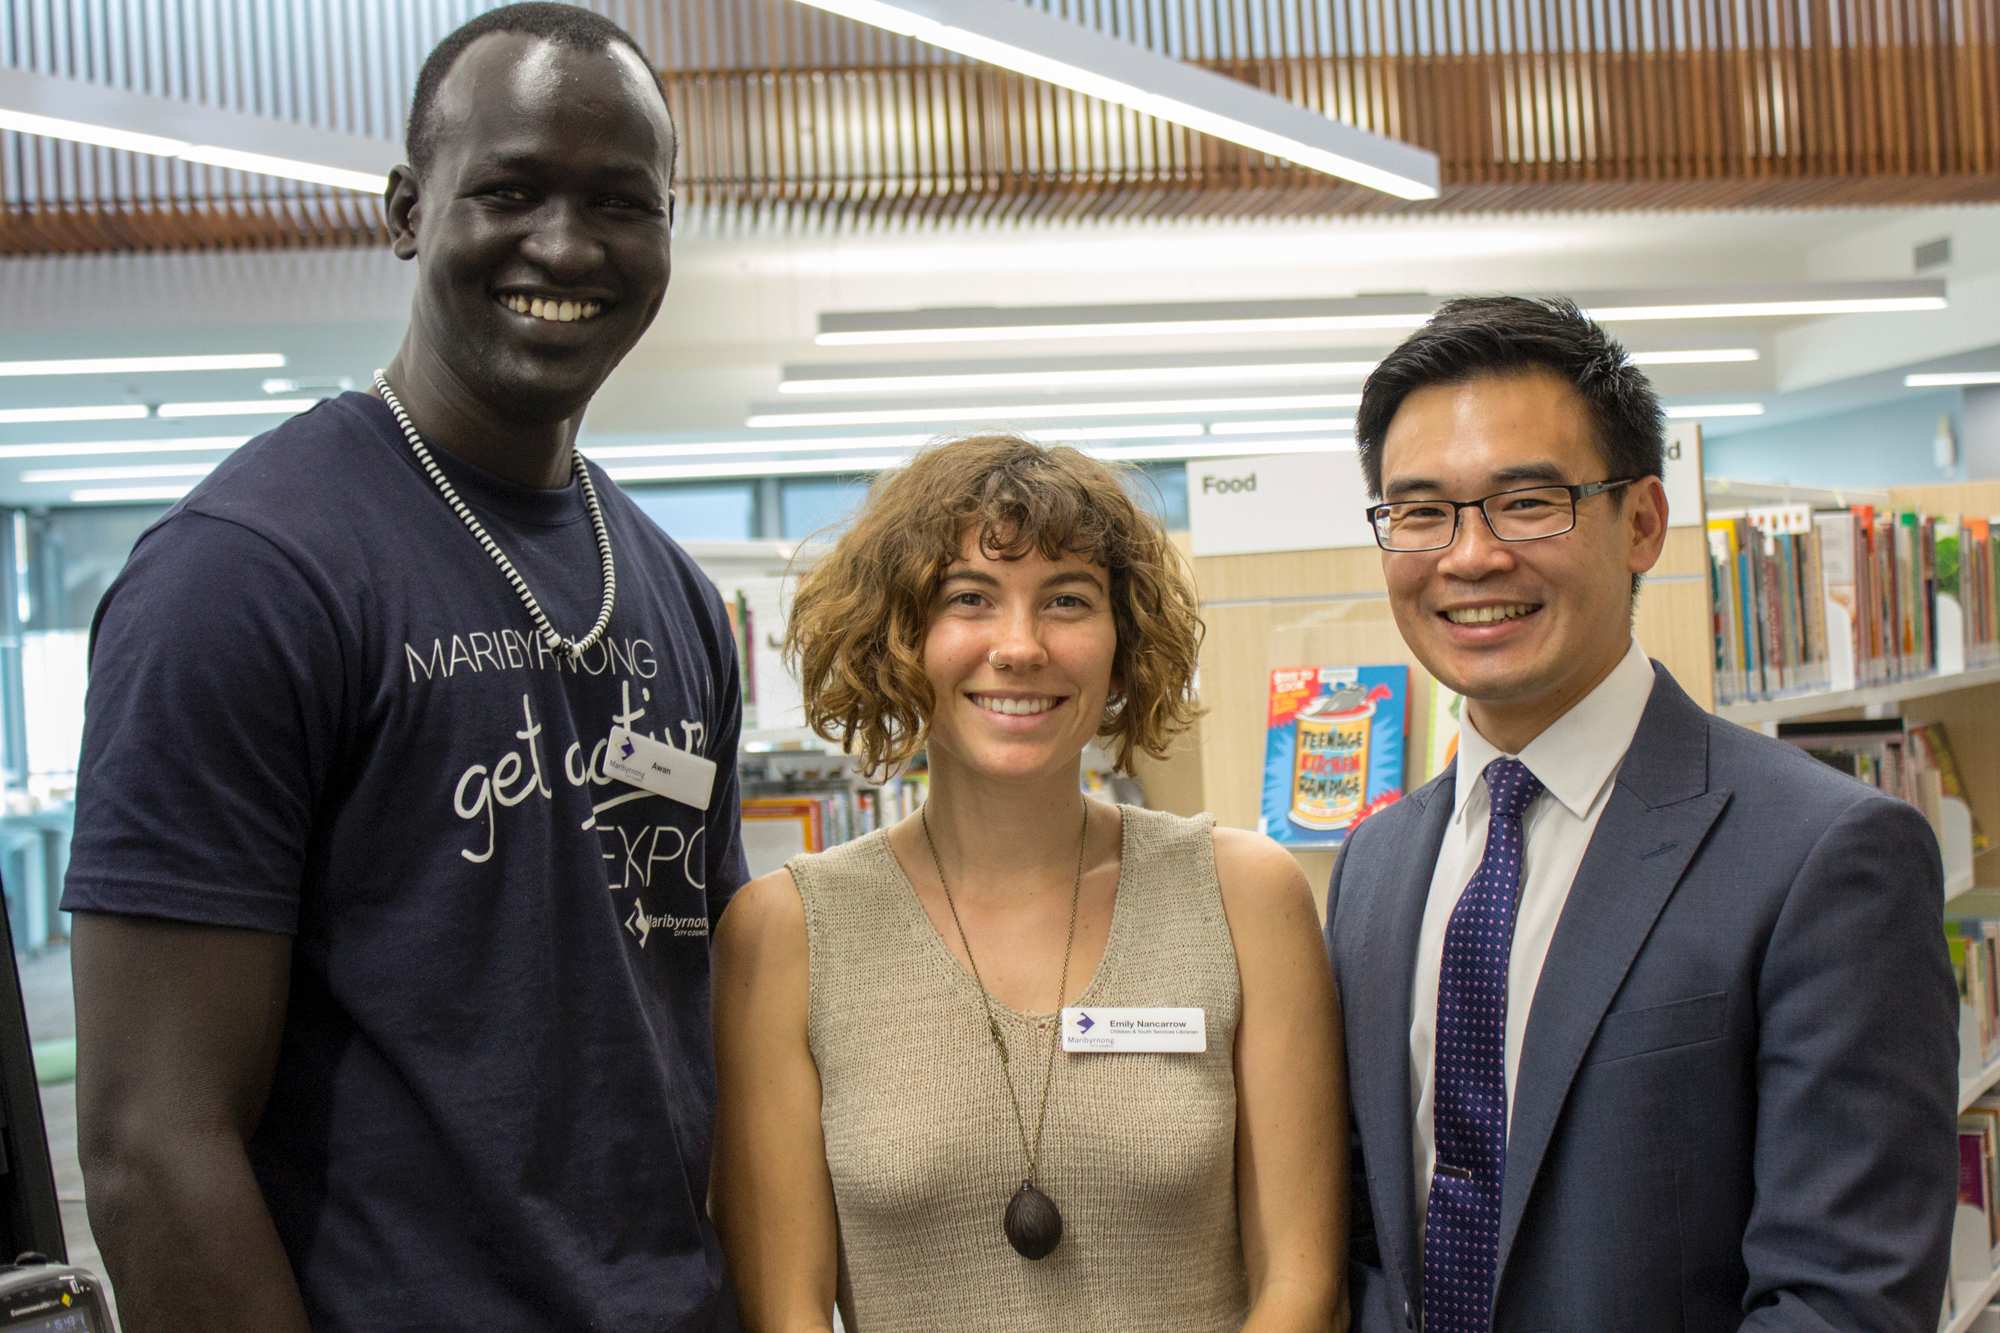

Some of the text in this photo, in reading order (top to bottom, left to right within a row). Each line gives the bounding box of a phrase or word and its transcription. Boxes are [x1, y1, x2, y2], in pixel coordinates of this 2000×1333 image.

[1202, 472, 1257, 496] Food
[454, 693, 552, 864] get
[651, 762, 672, 776] Awan
[1110, 1019, 1187, 1029] Emily Nancarrow
